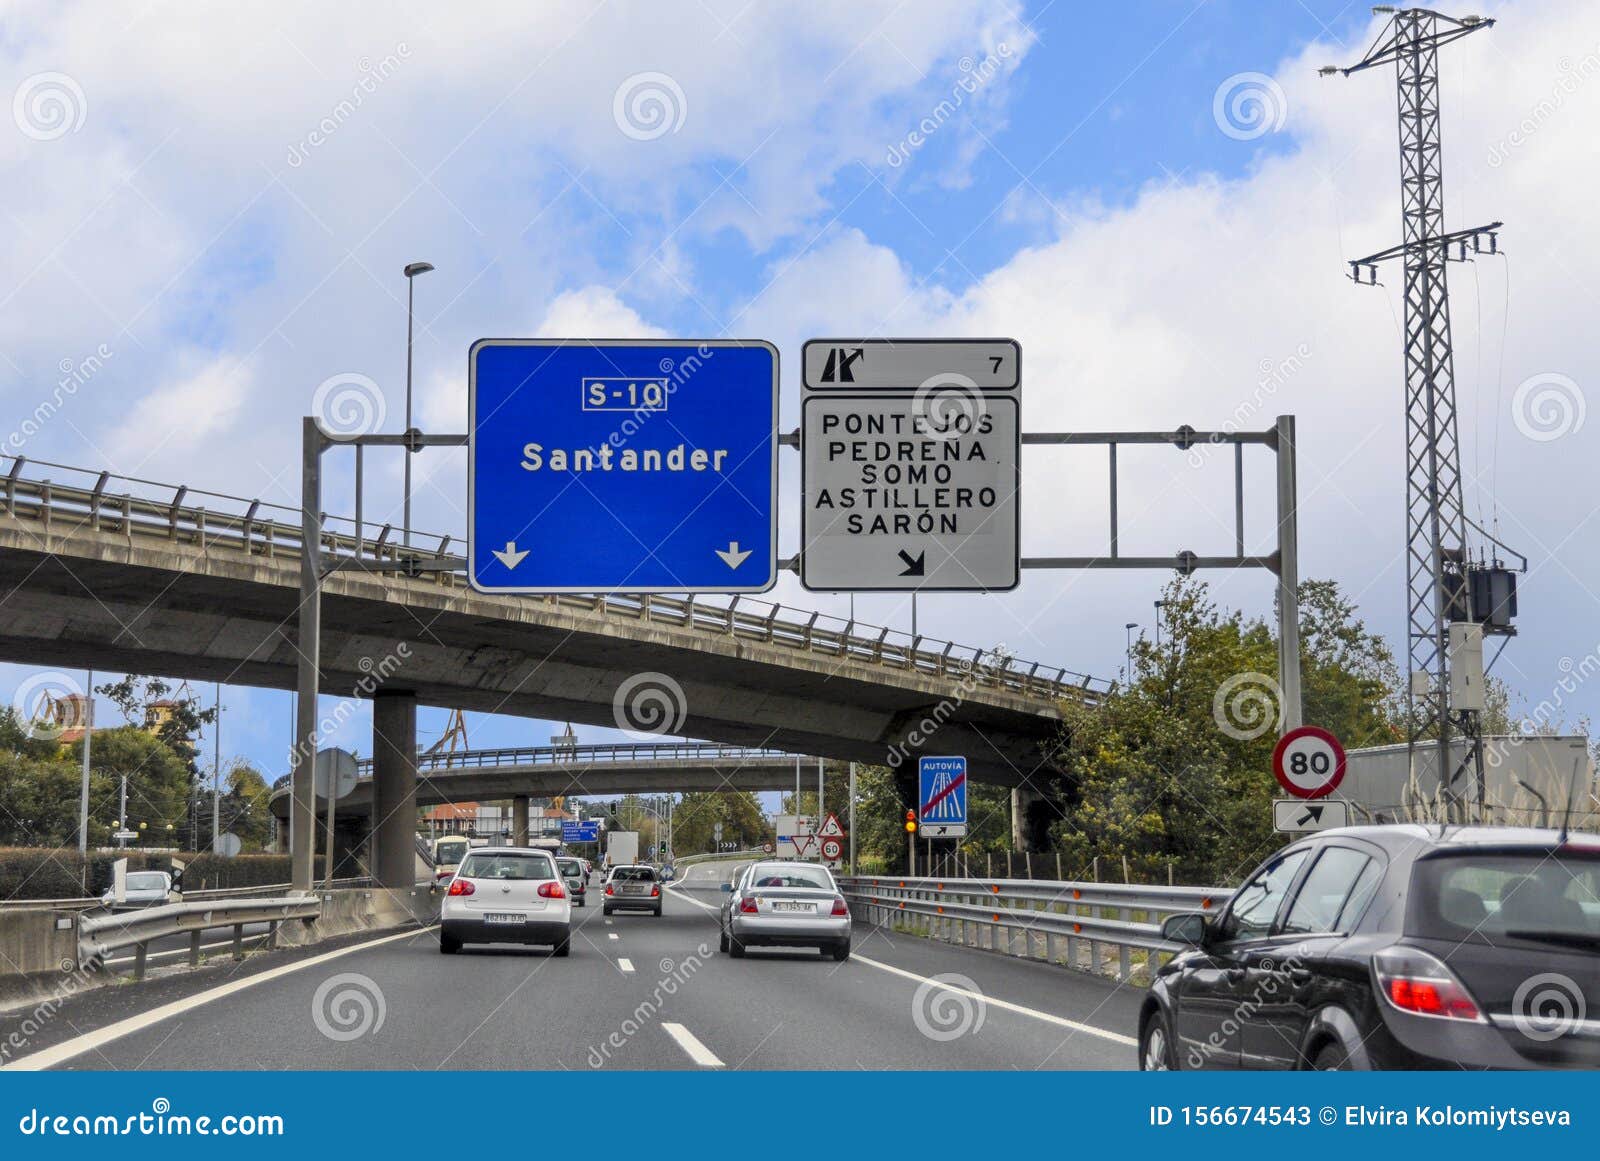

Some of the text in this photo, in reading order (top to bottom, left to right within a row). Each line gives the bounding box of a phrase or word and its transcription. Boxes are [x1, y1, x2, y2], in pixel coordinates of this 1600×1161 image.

[988, 356, 1004, 375] 7
[588, 383, 662, 406] S-10
[822, 413, 993, 435] PONTEJOS
[520, 443, 728, 471] Santander
[829, 438, 987, 462] PEDREÑA
[861, 463, 952, 485] SOMO
[815, 487, 996, 509] ASTILLERO
[847, 509, 958, 535] SARÓN
[923, 761, 962, 770] AUTOVÍA
[1290, 751, 1330, 775] 80
[825, 845, 838, 854] 60
